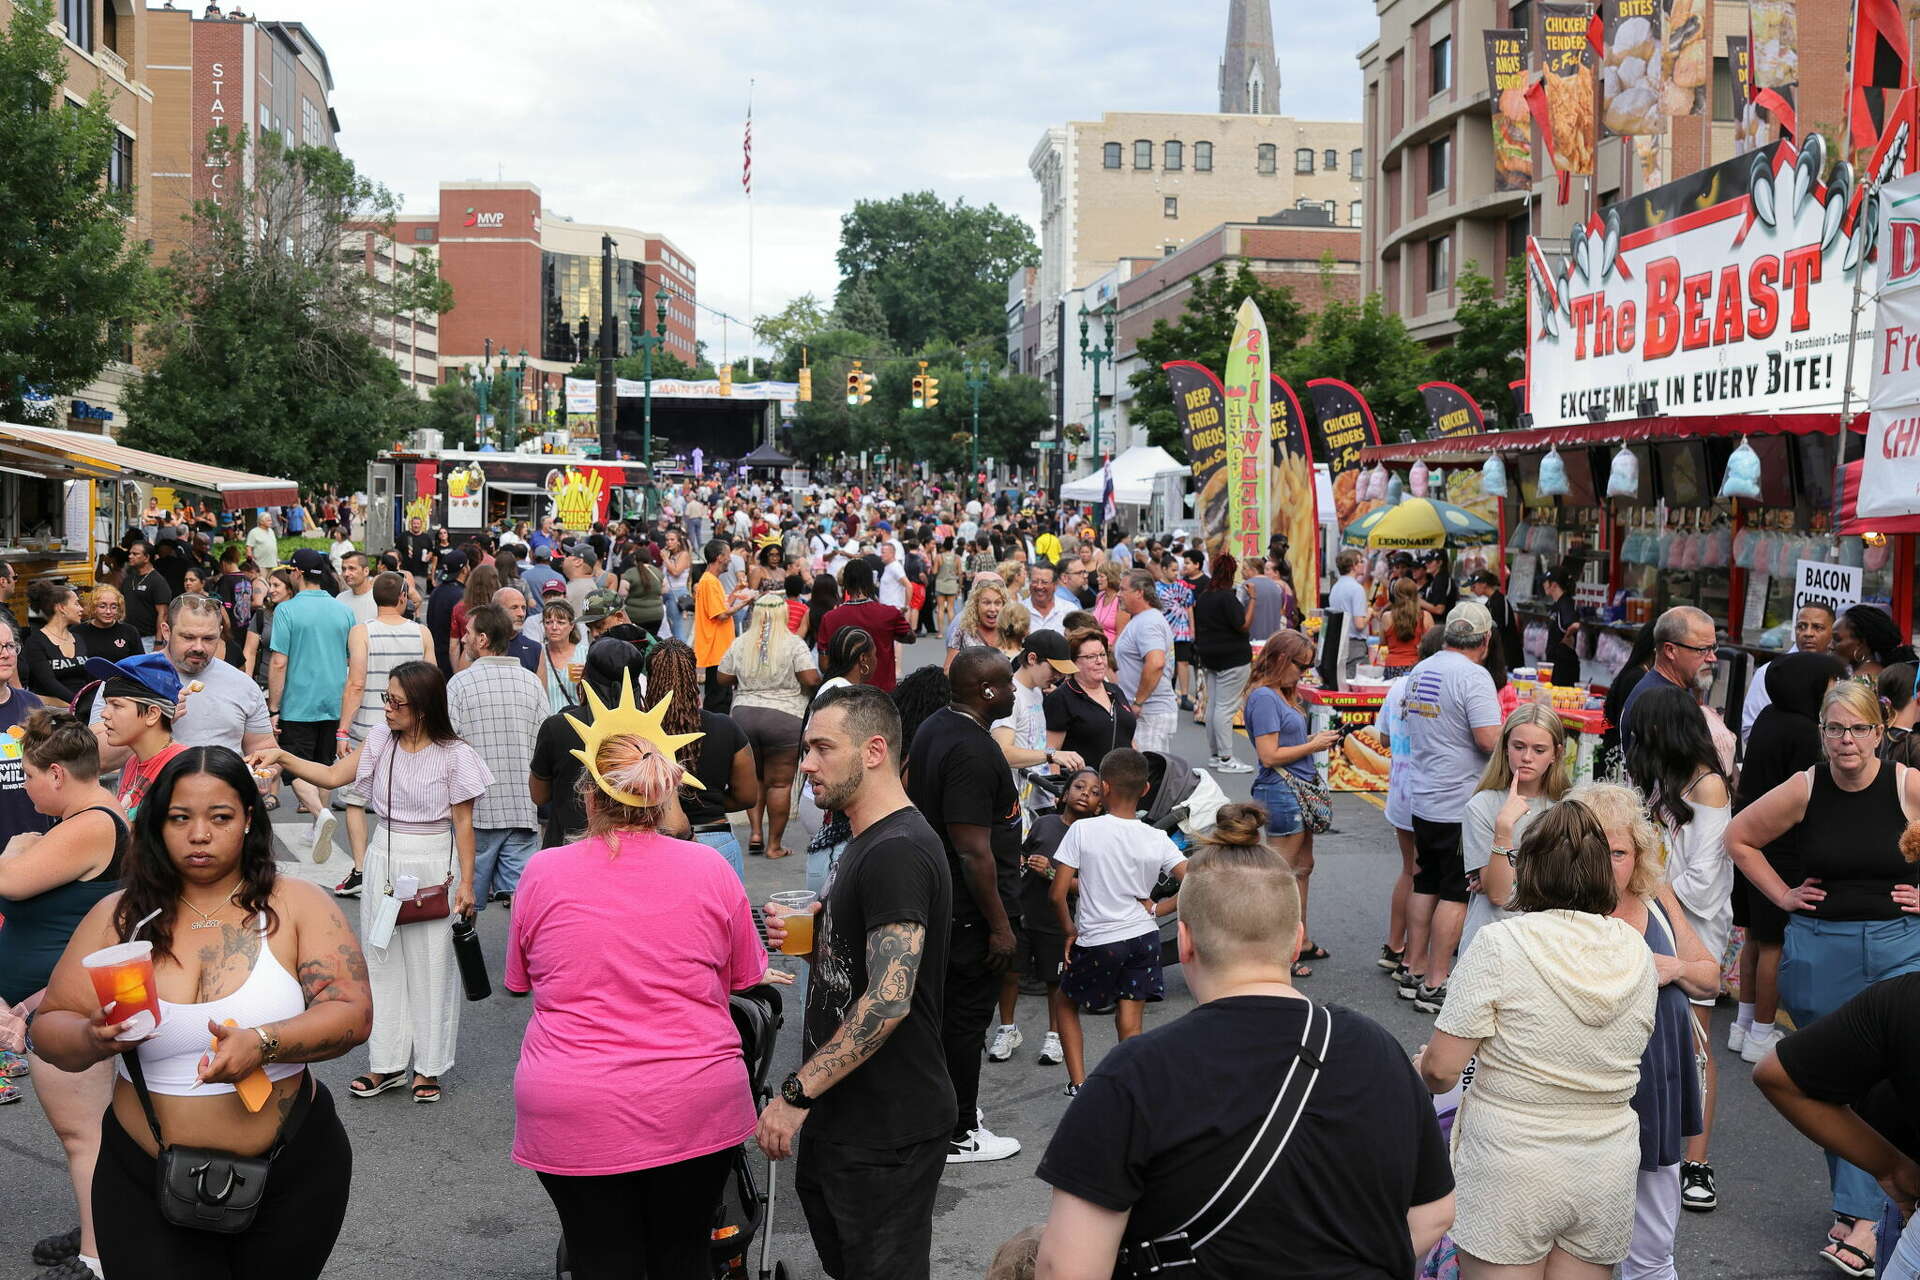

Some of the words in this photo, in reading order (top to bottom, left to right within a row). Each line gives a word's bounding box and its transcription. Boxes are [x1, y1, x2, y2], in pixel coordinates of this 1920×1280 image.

[1619, 0, 1653, 17] BITES
[1545, 17, 1587, 33] CHICKEN
[1495, 40, 1509, 55] 1/2
[1545, 36, 1587, 51] TENDERS
[478, 212, 504, 223] MVP
[1569, 291, 1636, 361] The
[1643, 243, 1822, 361] BEAST
[1785, 340, 1793, 353] By
[694, 384, 720, 395] STAG
[1560, 379, 1659, 419] EXCITEMENT
[1666, 376, 1685, 407] IN
[1694, 363, 1759, 404] EVERY
[1763, 350, 1832, 396] BITE!
[1185, 387, 1211, 411] DEEP
[1188, 407, 1220, 432] FRIED
[1323, 411, 1362, 434] CHICKEN
[1438, 408, 1470, 432] CHICKEN
[1192, 427, 1226, 452] OREOS
[1326, 428, 1366, 450] TENDERS
[1377, 537, 1437, 547] LEMONADE
[1806, 568, 1851, 592] BACON
[1342, 712, 1371, 723] HOT
